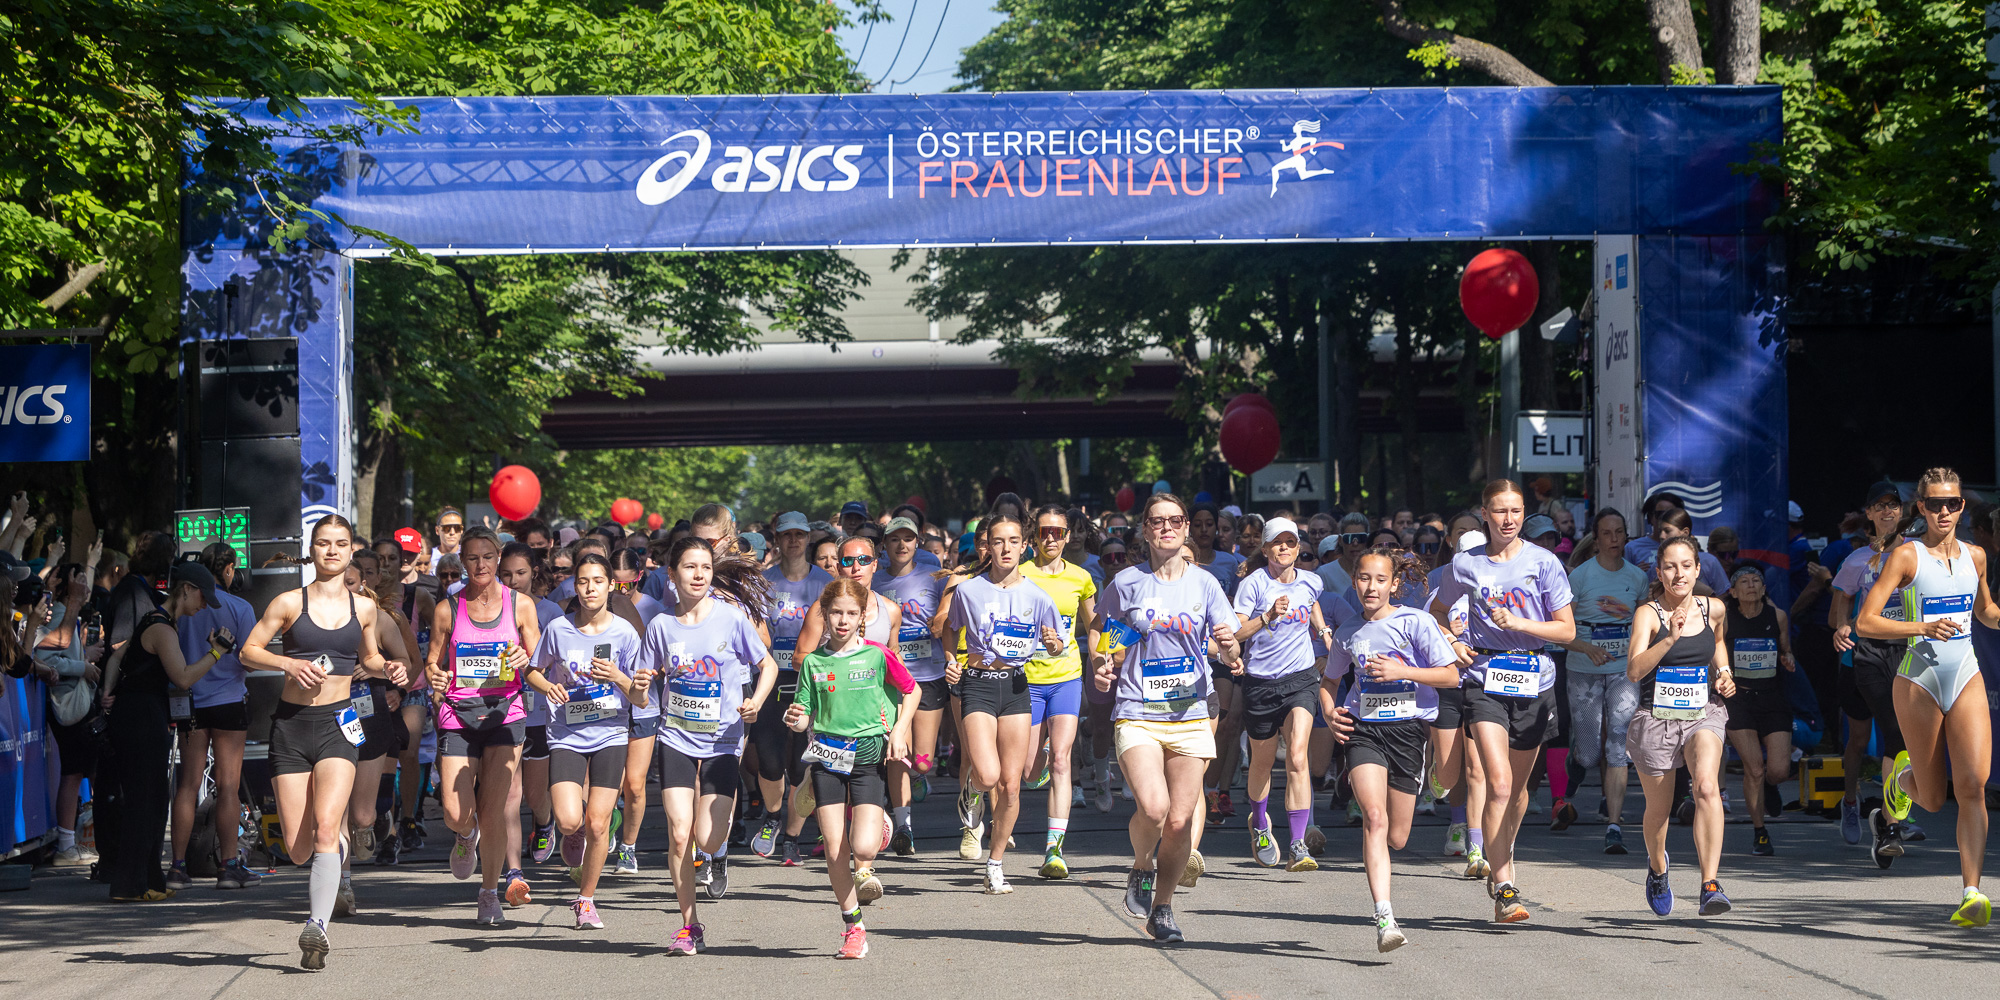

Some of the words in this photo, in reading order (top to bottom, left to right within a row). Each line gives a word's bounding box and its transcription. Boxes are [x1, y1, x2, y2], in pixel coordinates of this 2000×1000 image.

[918, 158, 1243, 198] FRAUENLAUF
[1532, 435, 1584, 456] ELIT
[1294, 471, 1313, 492] A
[178, 514, 247, 542] 00:02
[996, 638, 1023, 648] 14940
[462, 659, 492, 667] 10353
[1149, 678, 1180, 689] 19822
[1492, 672, 1524, 684] 10682
[1660, 686, 1693, 696] 30981
[569, 702, 602, 714] 29928
[672, 696, 705, 709] 32684
[1366, 697, 1397, 707] 22150
